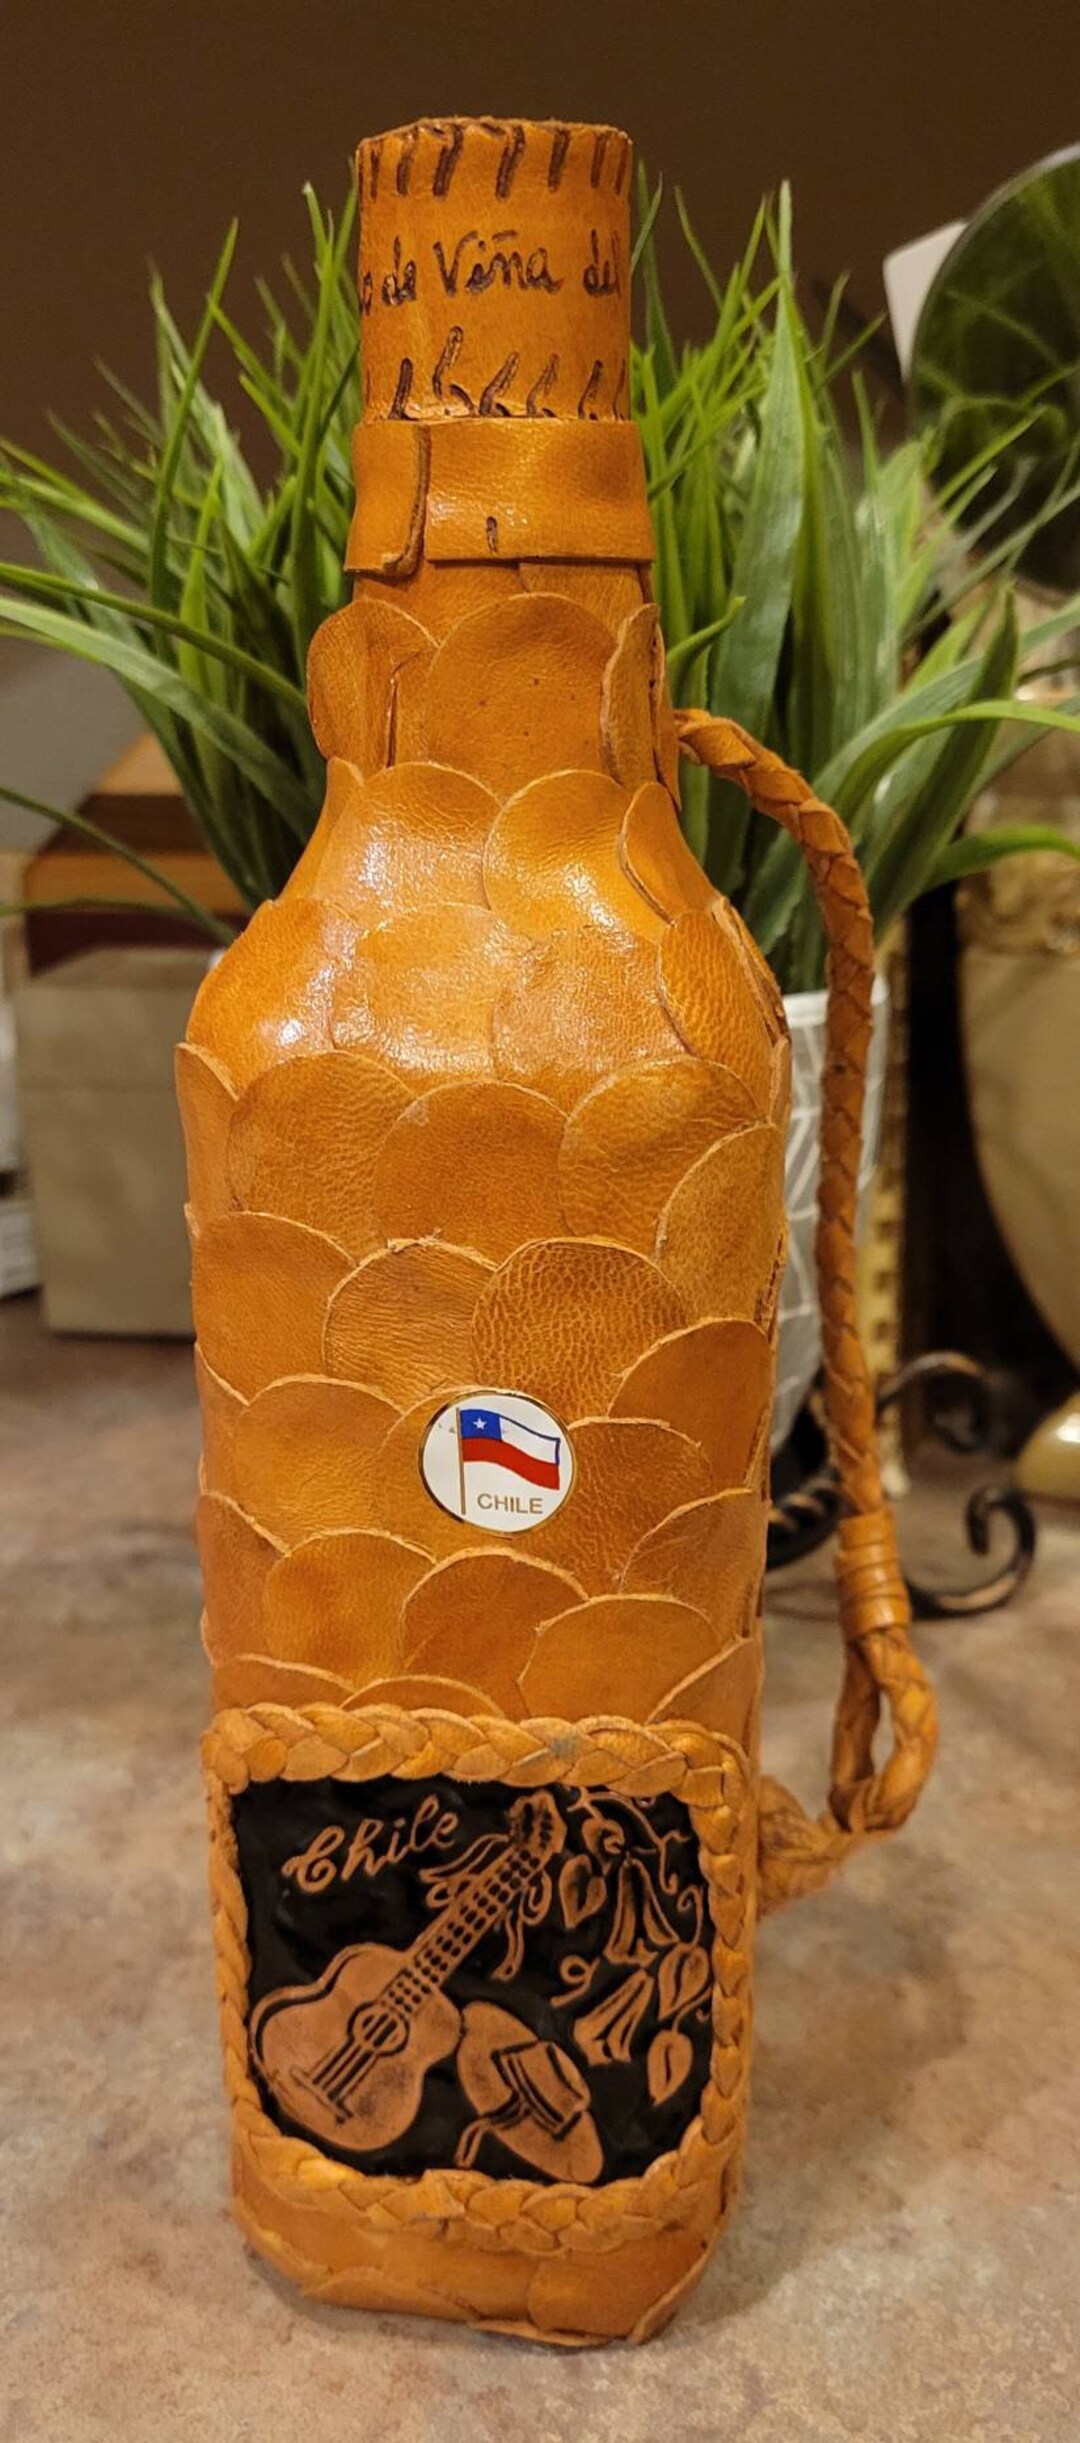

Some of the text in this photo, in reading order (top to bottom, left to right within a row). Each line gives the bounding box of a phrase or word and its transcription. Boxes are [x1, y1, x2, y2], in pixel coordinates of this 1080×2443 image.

[381, 235, 417, 306] de
[432, 229, 564, 298] Viña
[583, 228, 621, 298] del
[477, 1493, 543, 1514] CHILE
[281, 1795, 459, 1893] Chile
